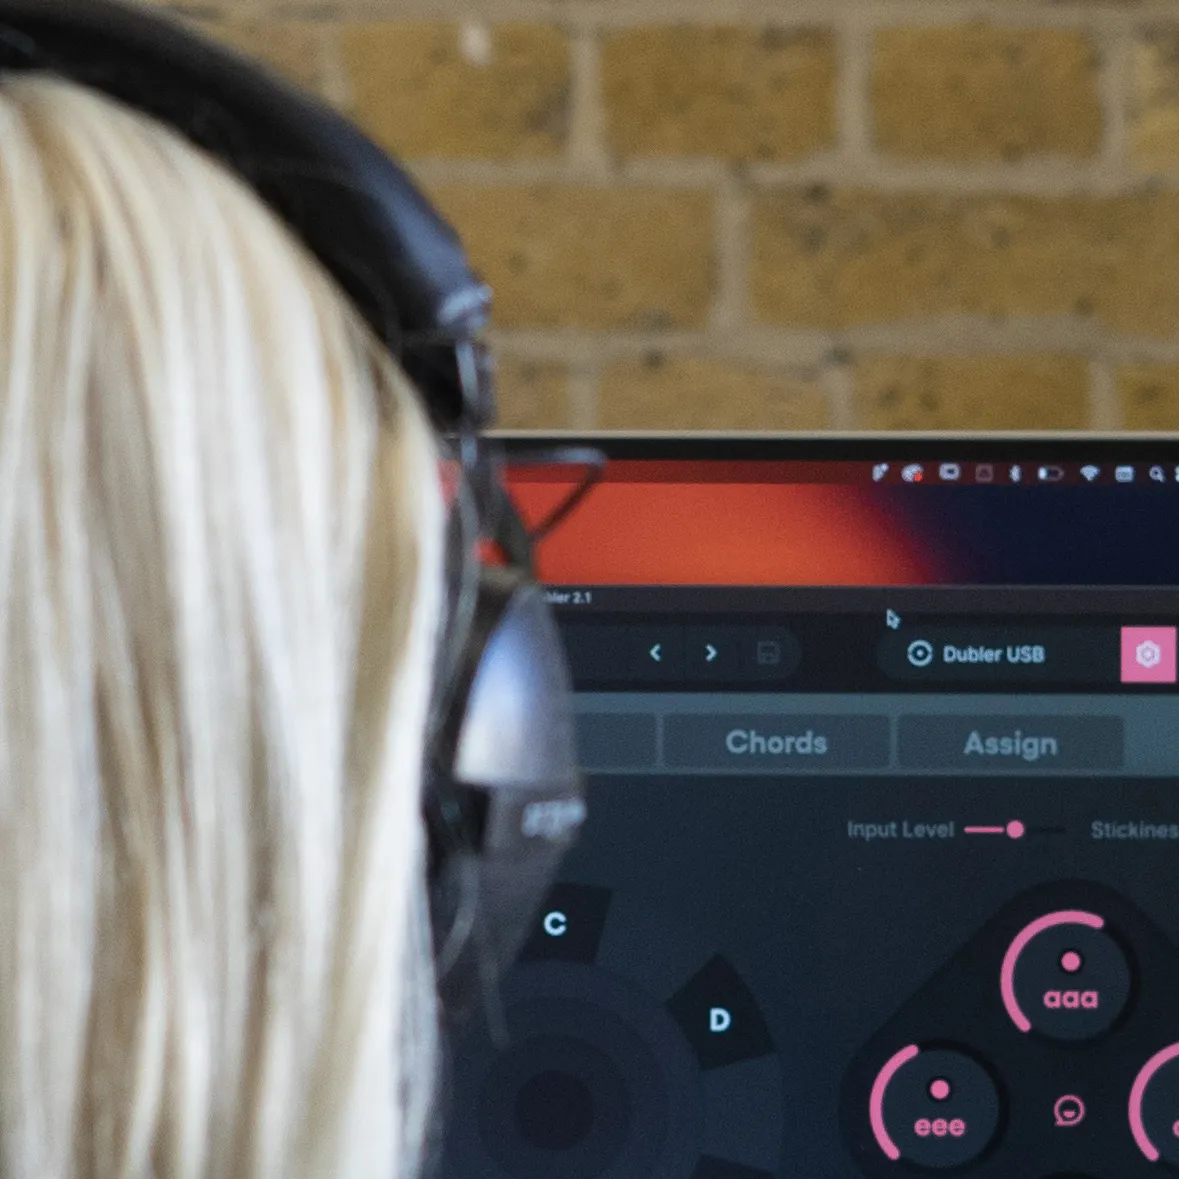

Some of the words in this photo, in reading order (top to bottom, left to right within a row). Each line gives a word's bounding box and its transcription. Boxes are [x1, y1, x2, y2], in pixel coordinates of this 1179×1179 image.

[573, 592, 591, 604] 2.1
[944, 646, 1002, 662] Dubler
[1007, 646, 1045, 663] USB
[726, 730, 827, 754] Chords
[964, 730, 1057, 761] Assign
[848, 821, 897, 841] Input
[902, 821, 954, 838] Level
[544, 912, 566, 935] C
[1044, 991, 1098, 1008] aaa
[710, 1008, 731, 1031] D
[915, 1119, 965, 1136] eee
